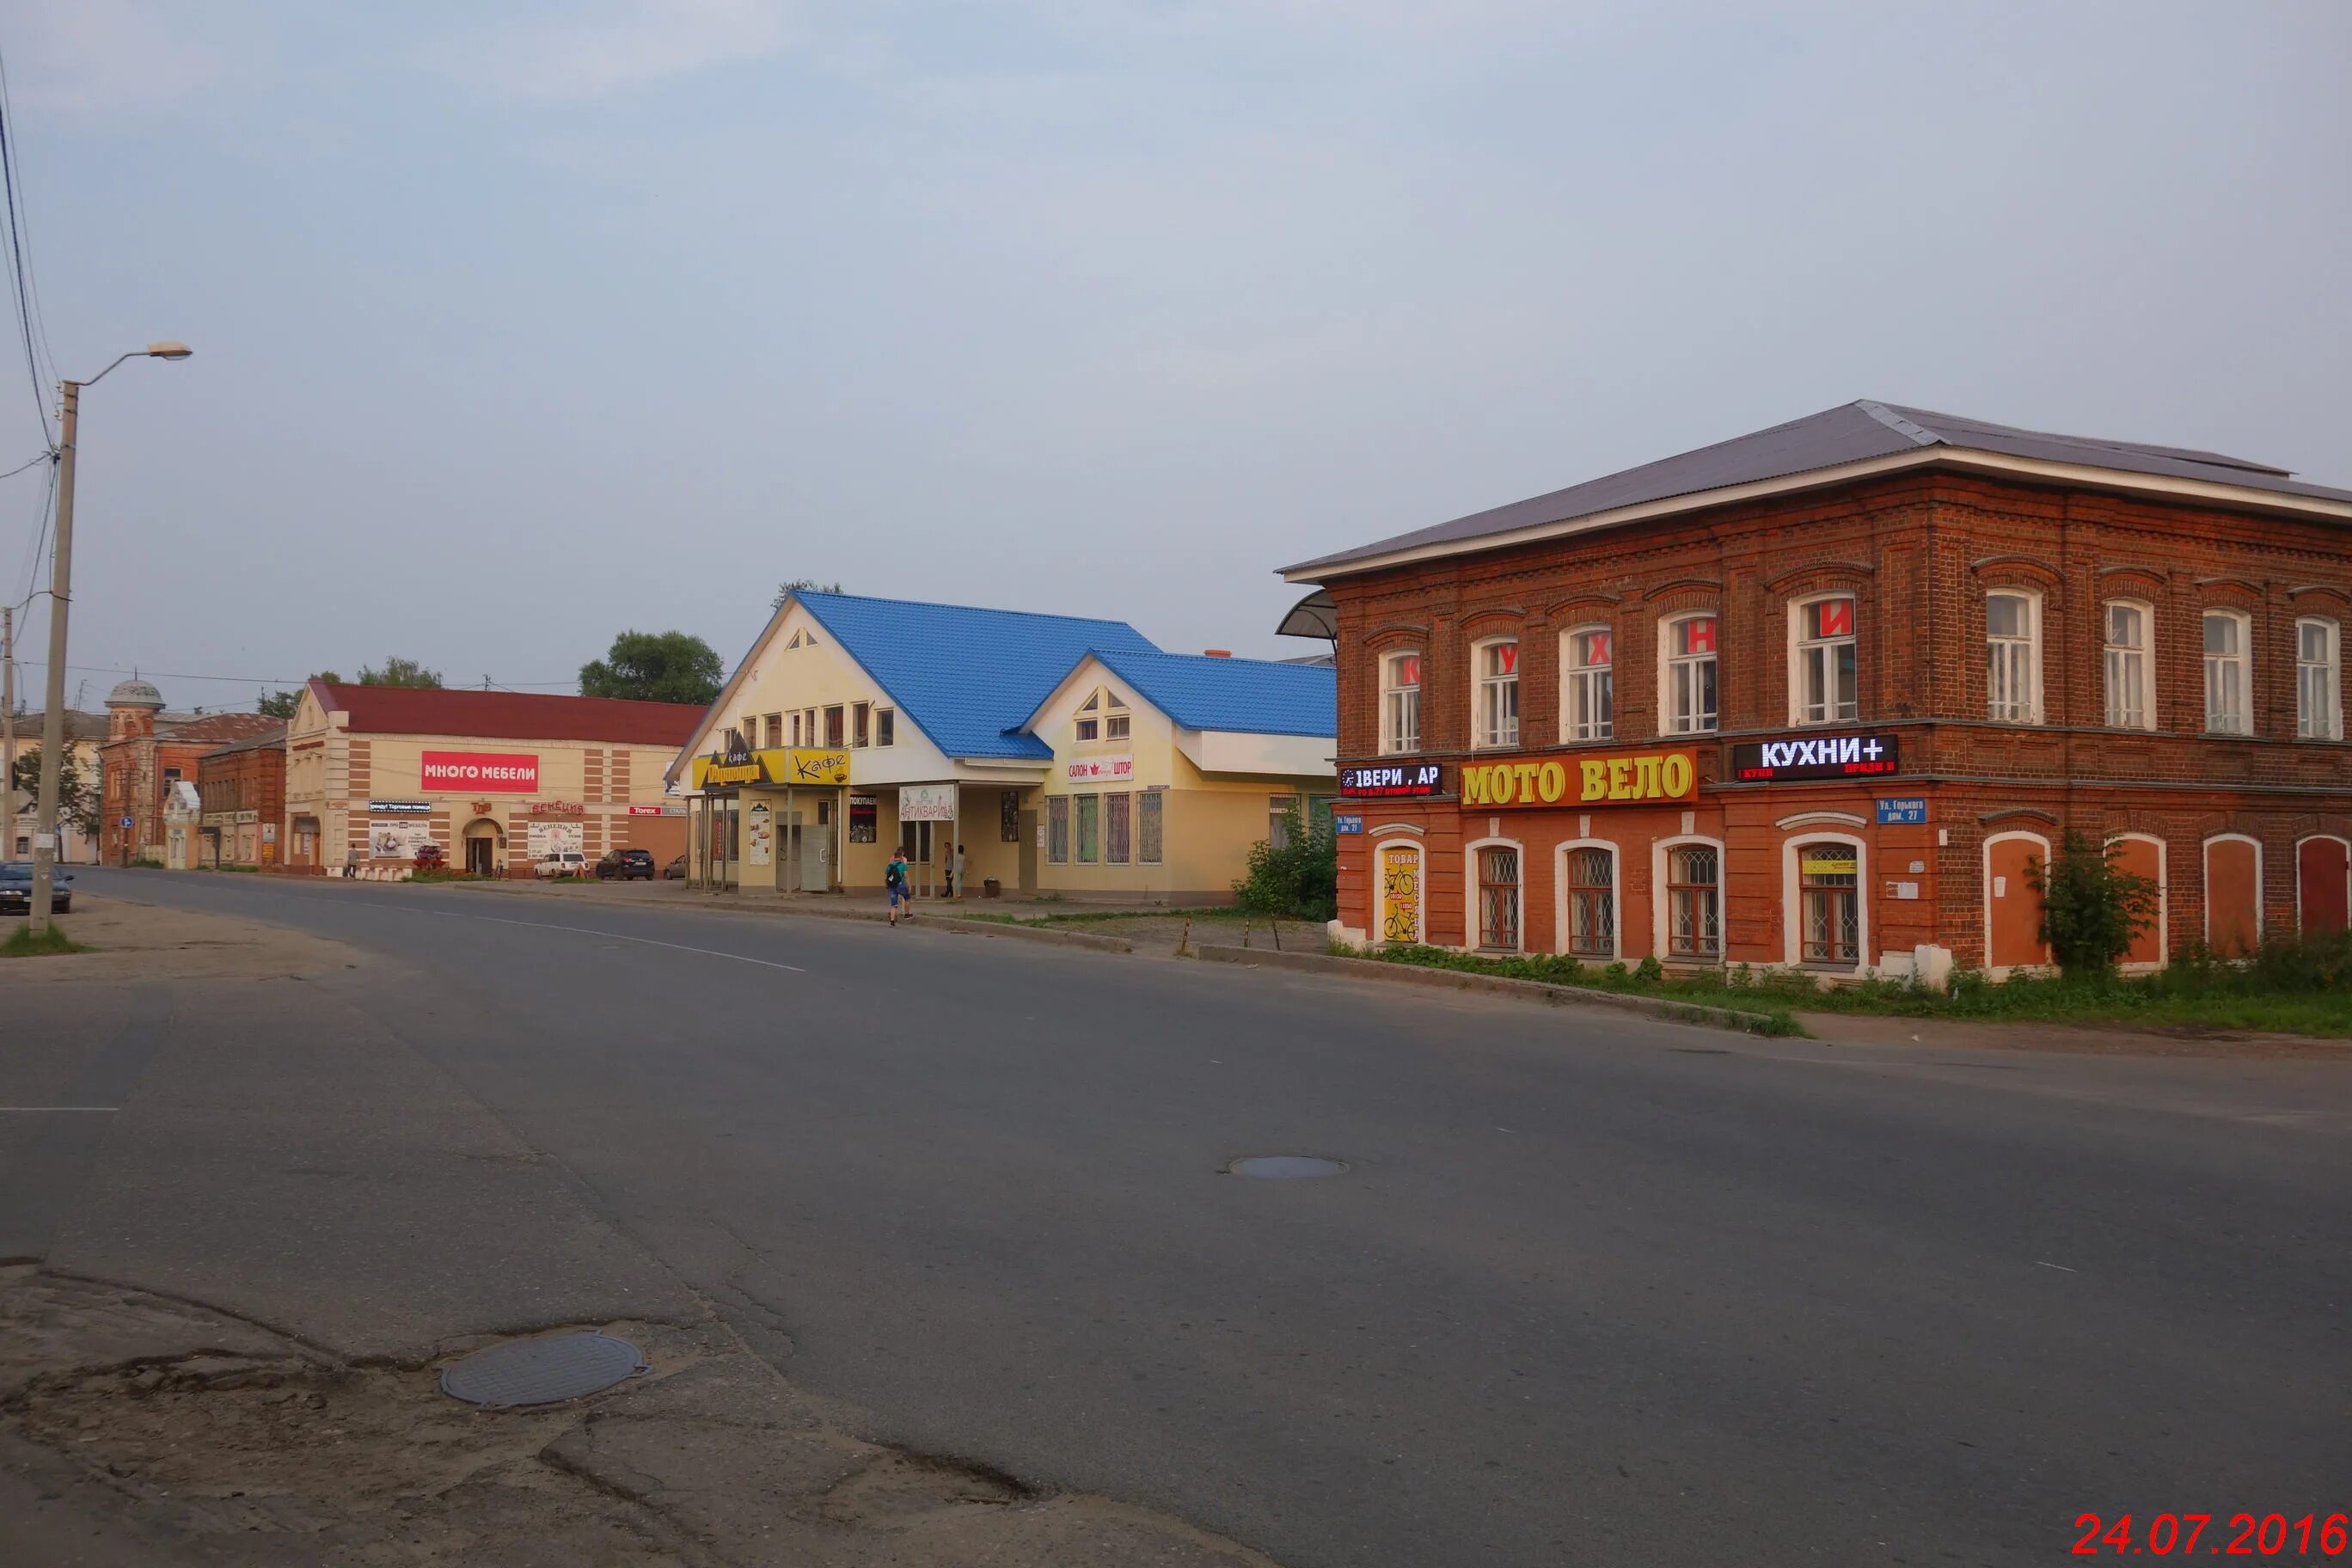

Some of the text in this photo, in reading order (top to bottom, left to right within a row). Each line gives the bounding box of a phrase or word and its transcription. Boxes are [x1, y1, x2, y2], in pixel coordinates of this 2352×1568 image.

[729, 751, 747, 765] кафе
[1762, 738, 1883, 768] КУХНИ+
[425, 764, 536, 780] МНОГО МЕБЕЛИ
[794, 754, 845, 779] Кафе
[1069, 764, 1087, 777] САЛОН
[1113, 761, 1132, 775] ШТОР
[1462, 754, 1693, 805] МОТО ВЕЛО
[530, 800, 585, 814] ВЕНЕЦИЯ
[1879, 799, 1924, 812] Ул. Горького
[1908, 810, 1918, 820] 27
[538, 824, 573, 833] ВЕНЕЦИЯ
[1388, 854, 1418, 864] ТОВАР
